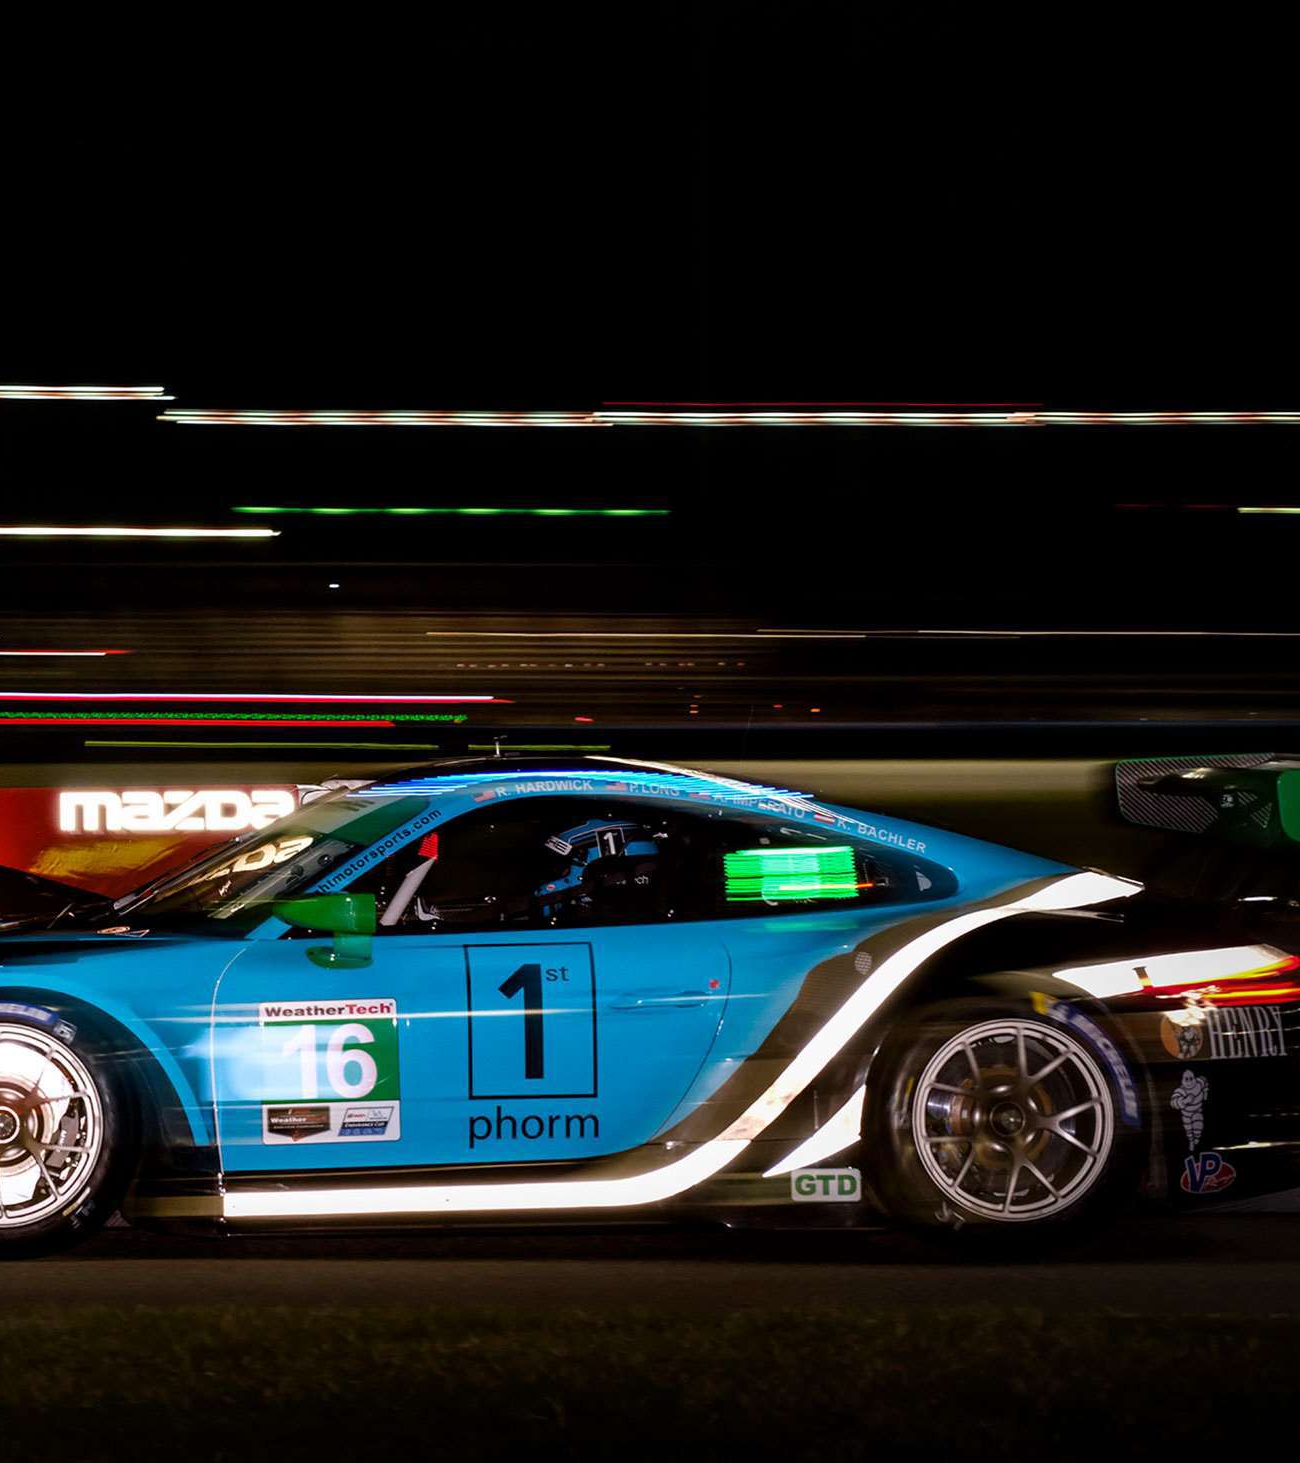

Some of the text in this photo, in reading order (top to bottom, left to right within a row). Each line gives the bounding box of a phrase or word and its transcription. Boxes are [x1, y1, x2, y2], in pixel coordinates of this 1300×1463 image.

[495, 780, 595, 798] R. HARDWICK
[856, 823, 927, 853] BACHLER
[265, 1003, 392, 1017] WeatherTech
[1205, 1006, 1288, 1059] HENRY
[283, 1023, 377, 1099] 16
[469, 1105, 599, 1149] phorm
[795, 1174, 857, 1196] GTD
